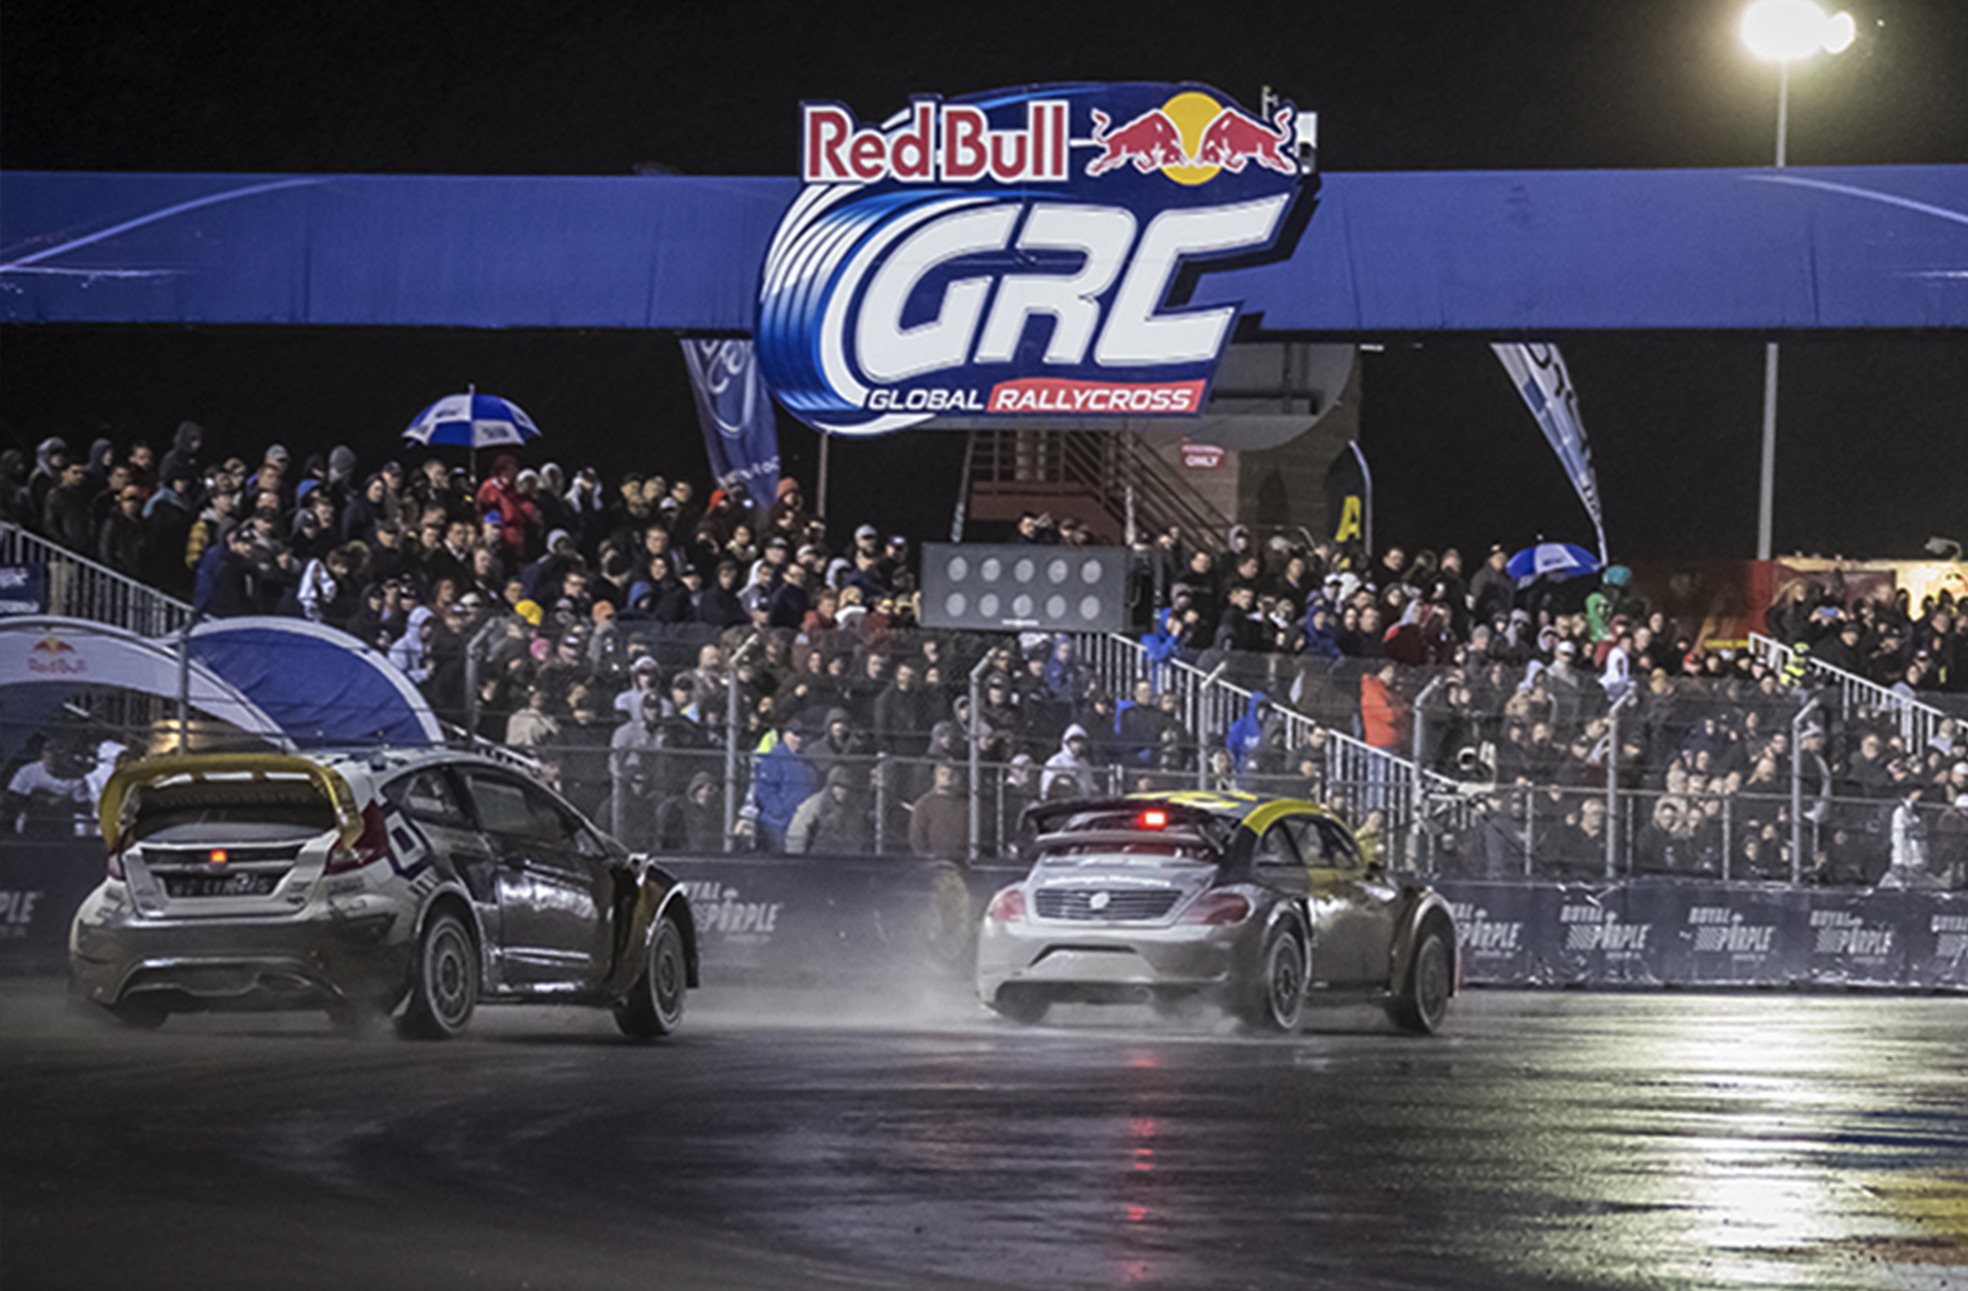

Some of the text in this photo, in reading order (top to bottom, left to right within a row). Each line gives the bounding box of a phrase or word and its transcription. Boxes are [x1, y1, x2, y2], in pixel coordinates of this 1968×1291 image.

[804, 100, 1068, 181] Red Bull
[856, 194, 1290, 383] GRC
[868, 388, 1194, 411] GLOBAL RALLYCROSS
